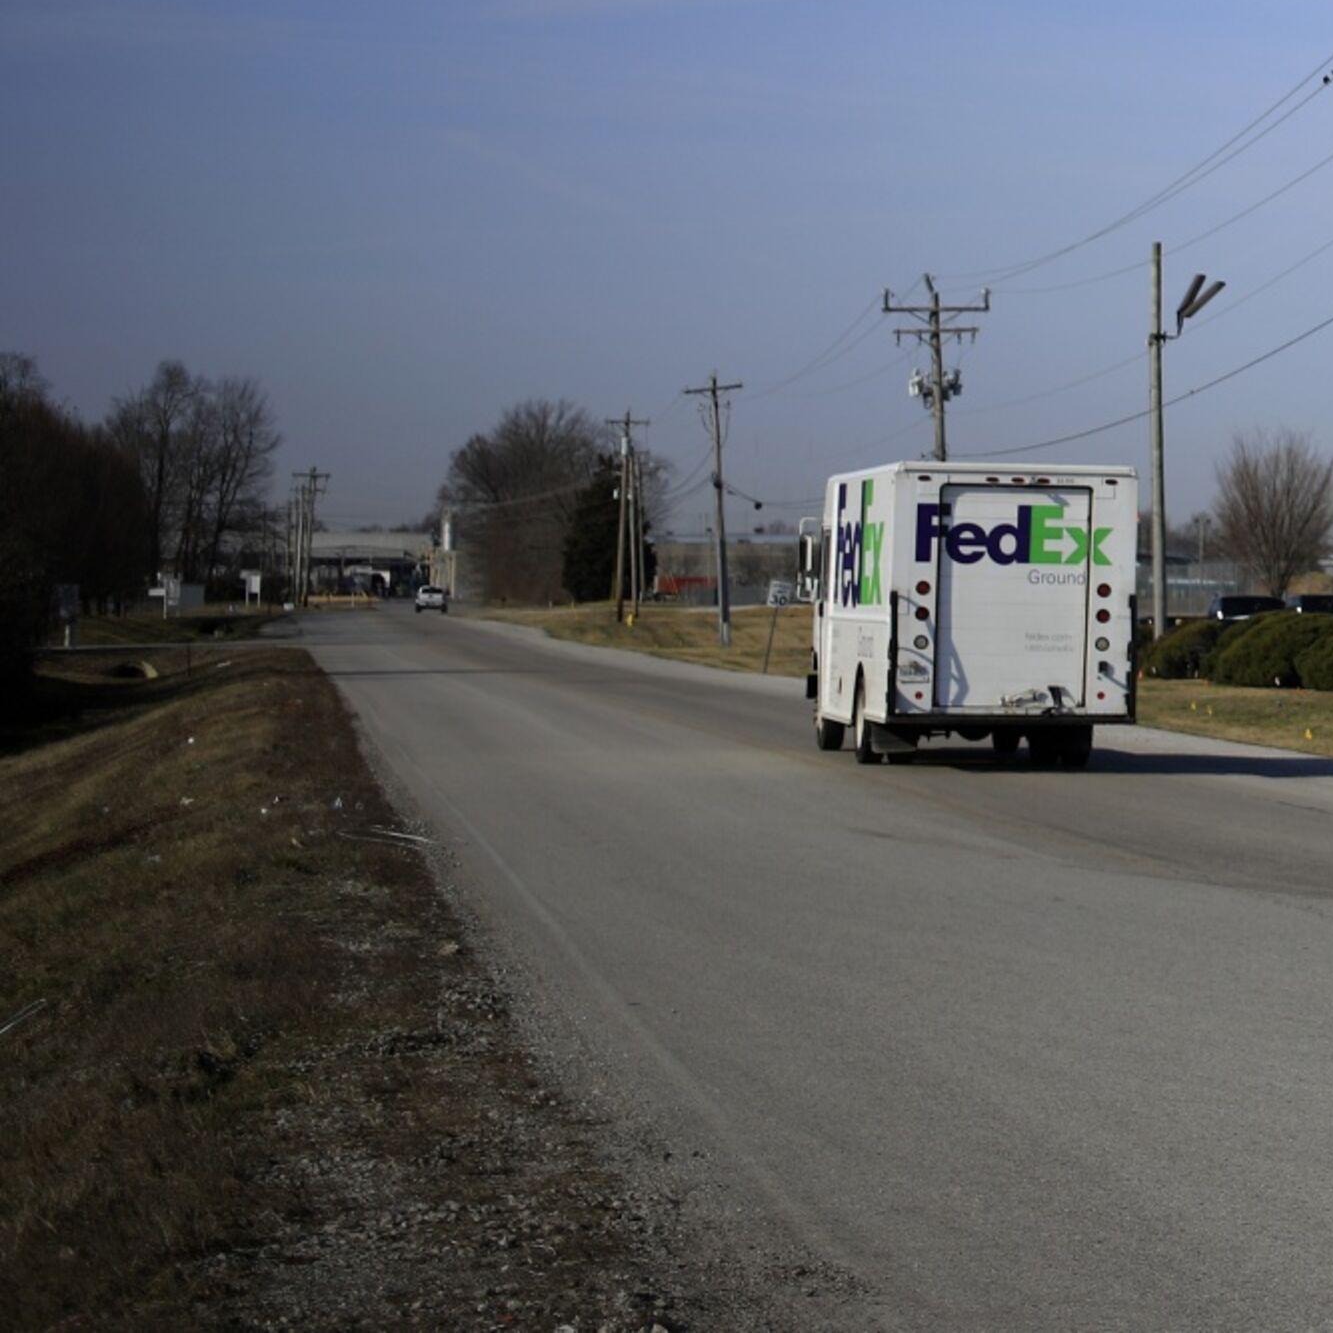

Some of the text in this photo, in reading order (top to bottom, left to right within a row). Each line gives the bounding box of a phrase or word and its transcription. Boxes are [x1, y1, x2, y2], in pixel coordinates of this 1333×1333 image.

[834, 478, 885, 609] FedEx
[914, 502, 1114, 566] FedEx
[1027, 568, 1087, 586] Ground
